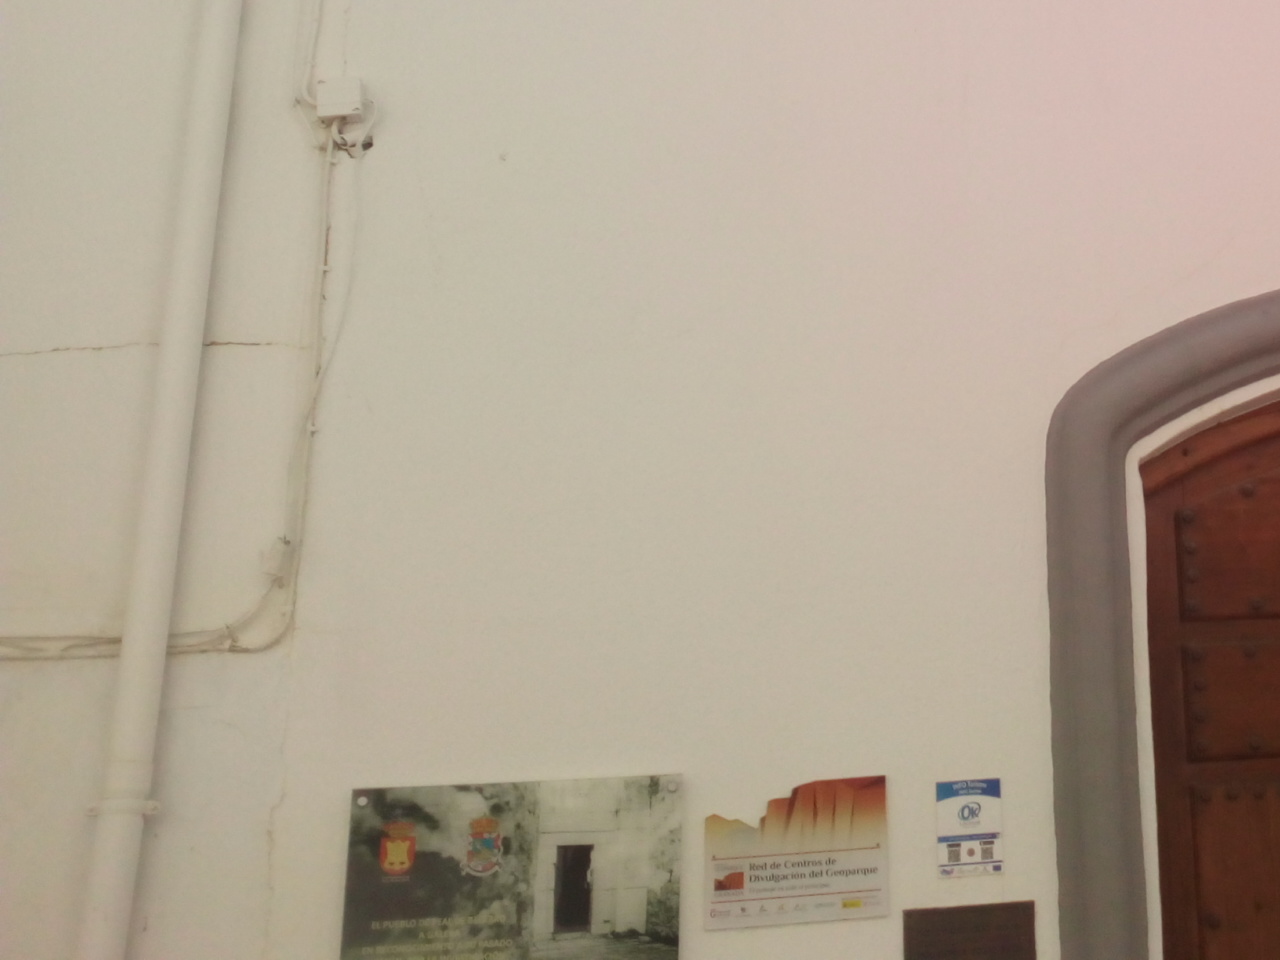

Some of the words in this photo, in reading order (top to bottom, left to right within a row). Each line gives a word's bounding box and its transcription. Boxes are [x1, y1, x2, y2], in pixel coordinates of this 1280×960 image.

[749, 862, 768, 872] Red
[769, 860, 782, 870] de
[783, 858, 823, 869] Centros
[825, 857, 837, 867] de
[749, 869, 807, 884] Divulgación
[808, 868, 823, 879] del
[825, 865, 879, 878] Geoparque
